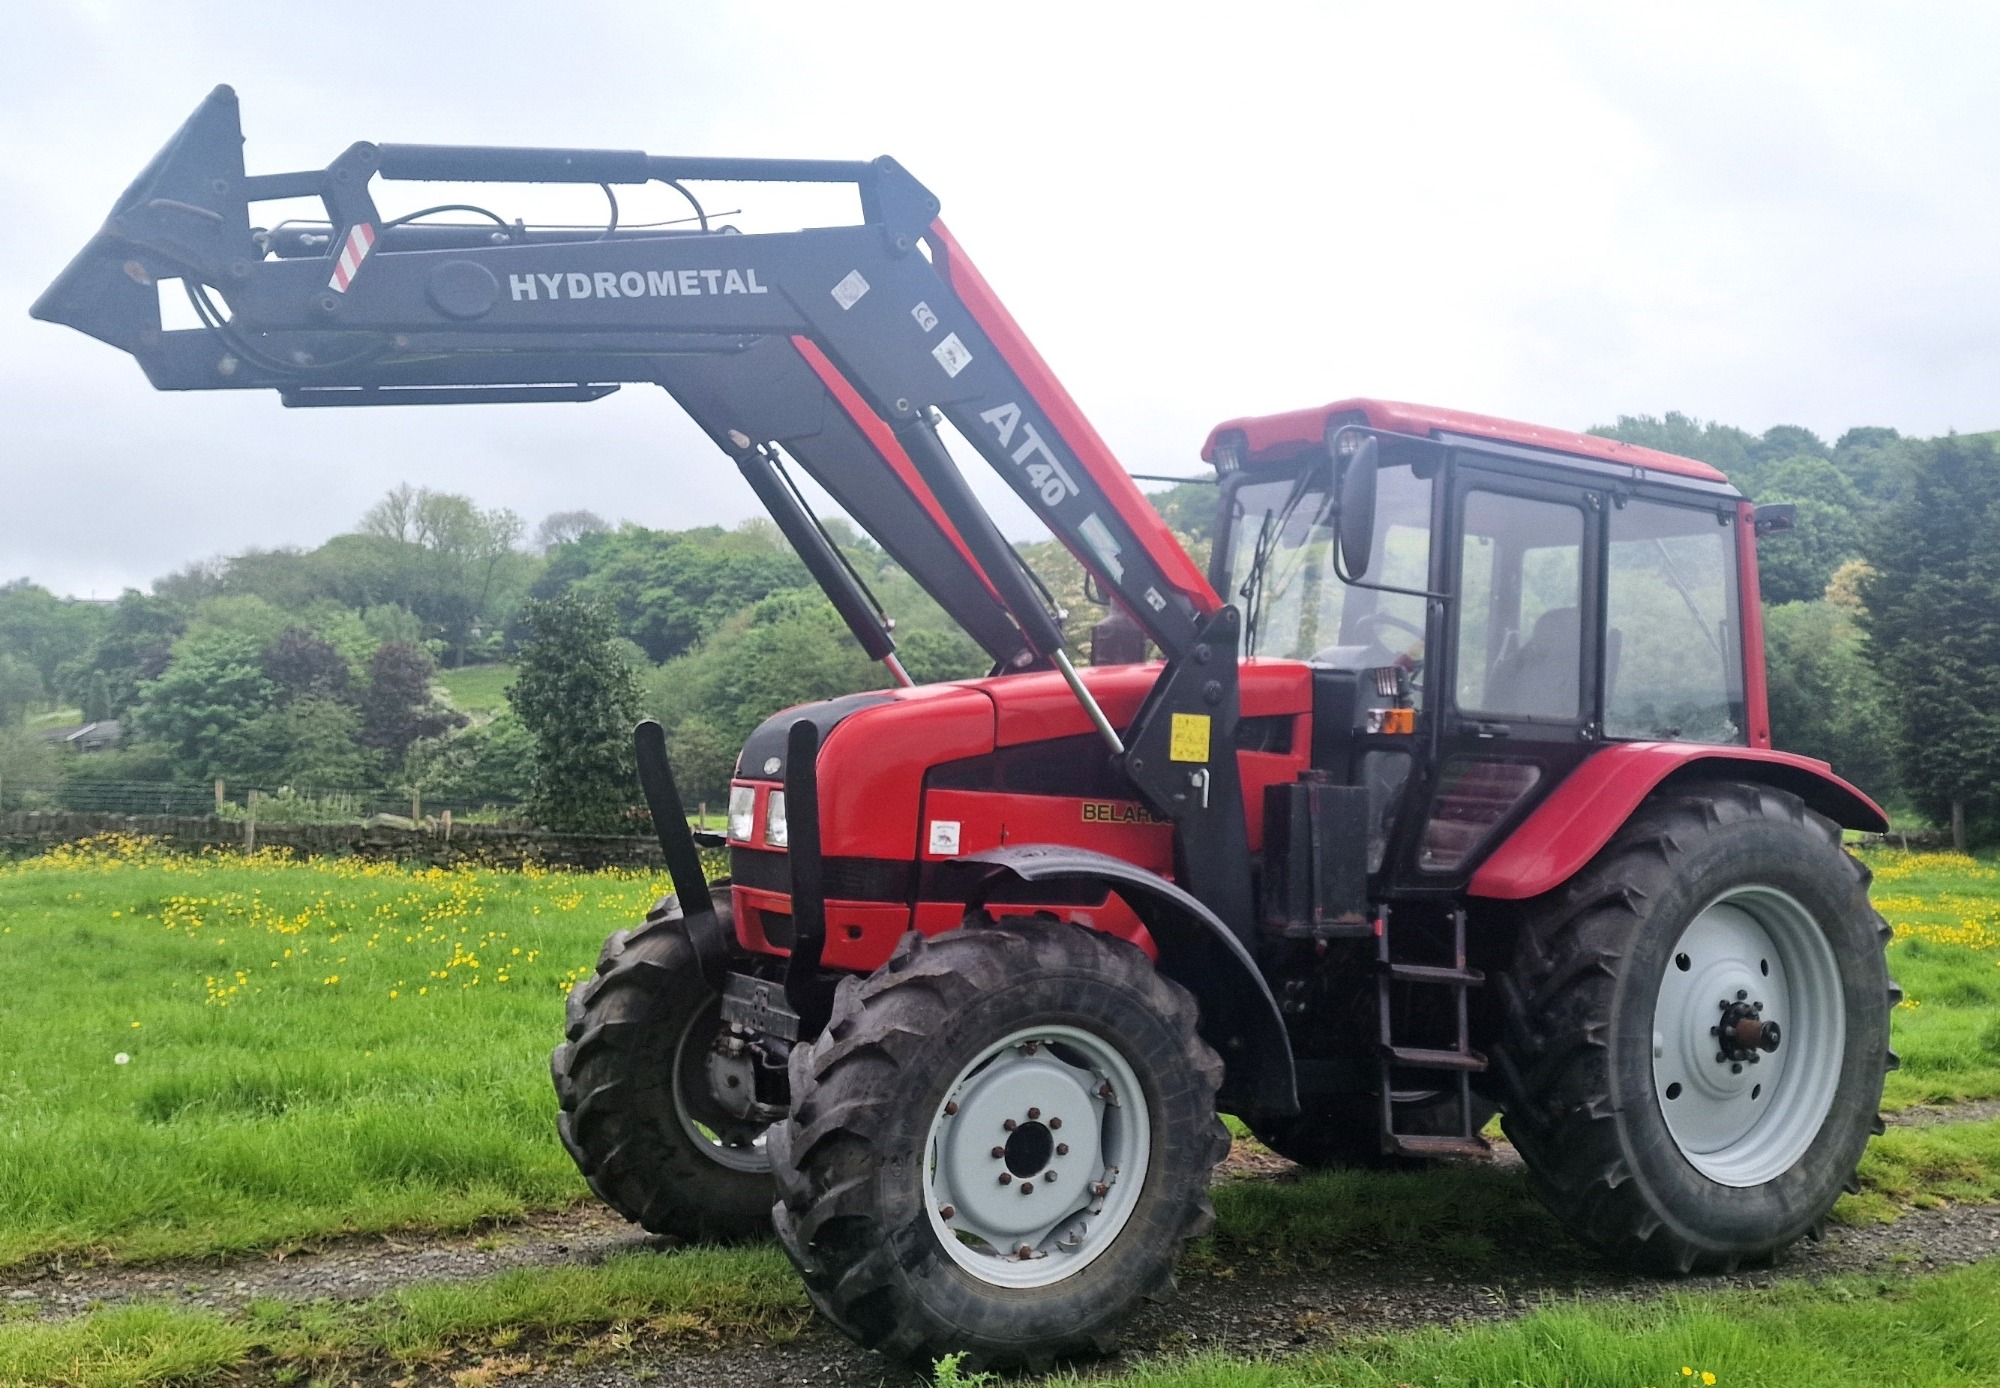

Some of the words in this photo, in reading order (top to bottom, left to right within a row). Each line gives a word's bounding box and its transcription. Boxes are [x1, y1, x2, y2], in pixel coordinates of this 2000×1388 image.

[509, 268, 768, 301] HYDROMETAL
[916, 307, 936, 329] CE
[980, 402, 1080, 507] AT40
[1082, 802, 1175, 825] BELAR
